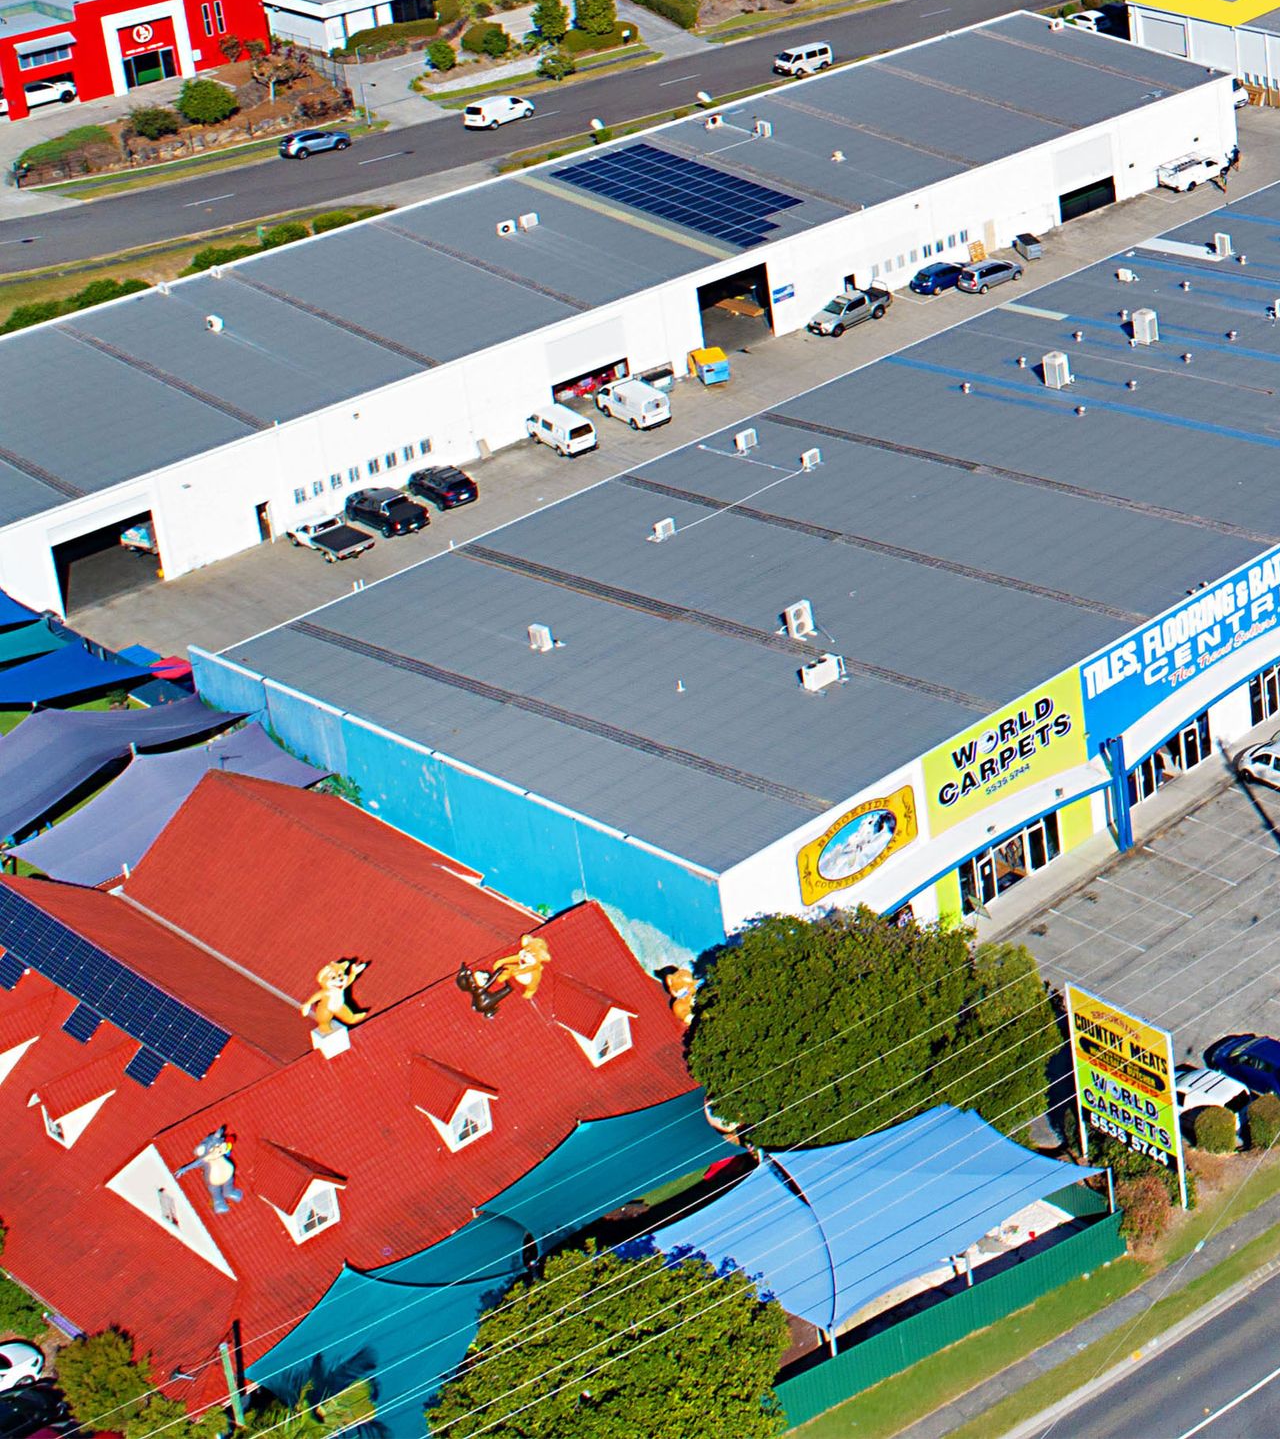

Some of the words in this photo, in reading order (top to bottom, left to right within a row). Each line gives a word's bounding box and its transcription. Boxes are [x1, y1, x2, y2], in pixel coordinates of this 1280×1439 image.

[1141, 582, 1235, 665] FLOORING
[1235, 581, 1249, 608] &
[938, 712, 1073, 807] CARPETS
[951, 697, 1056, 772] WORLD
[1073, 1012, 1124, 1054] COUNTRY
[1130, 1041, 1168, 1076] MEATS
[1083, 1087, 1172, 1150] CARPETS
[1091, 1070, 1159, 1120] WORLD
[1089, 1112, 1128, 1144] 5535
[1130, 1134, 1169, 1166] 5744
